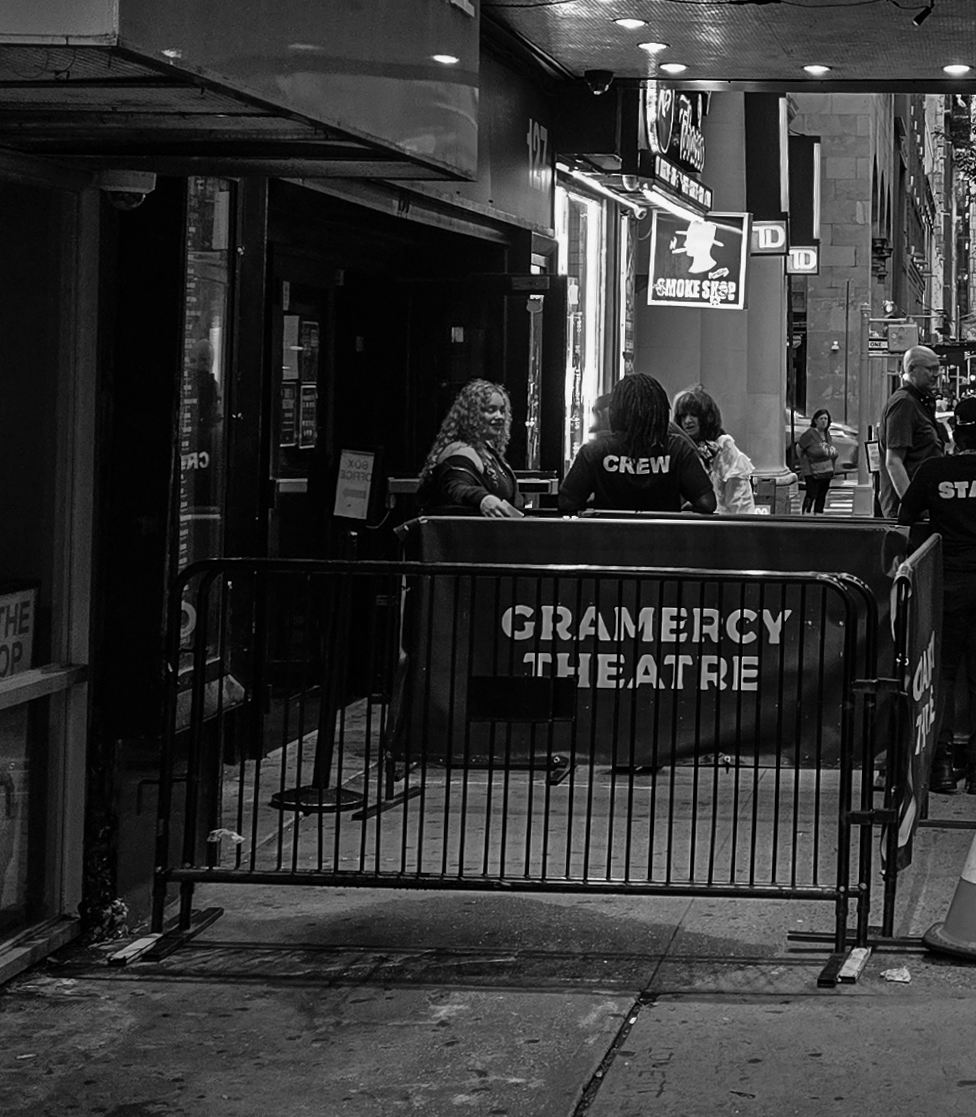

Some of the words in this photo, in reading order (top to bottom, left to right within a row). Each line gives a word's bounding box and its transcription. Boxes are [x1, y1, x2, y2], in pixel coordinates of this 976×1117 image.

[752, 224, 786, 249] TD
[789, 249, 817, 270] TD
[653, 278, 700, 299] SMOKE
[603, 454, 671, 475] CREW
[501, 604, 793, 646] GRAMERCY
[522, 651, 760, 692] THEATRE
